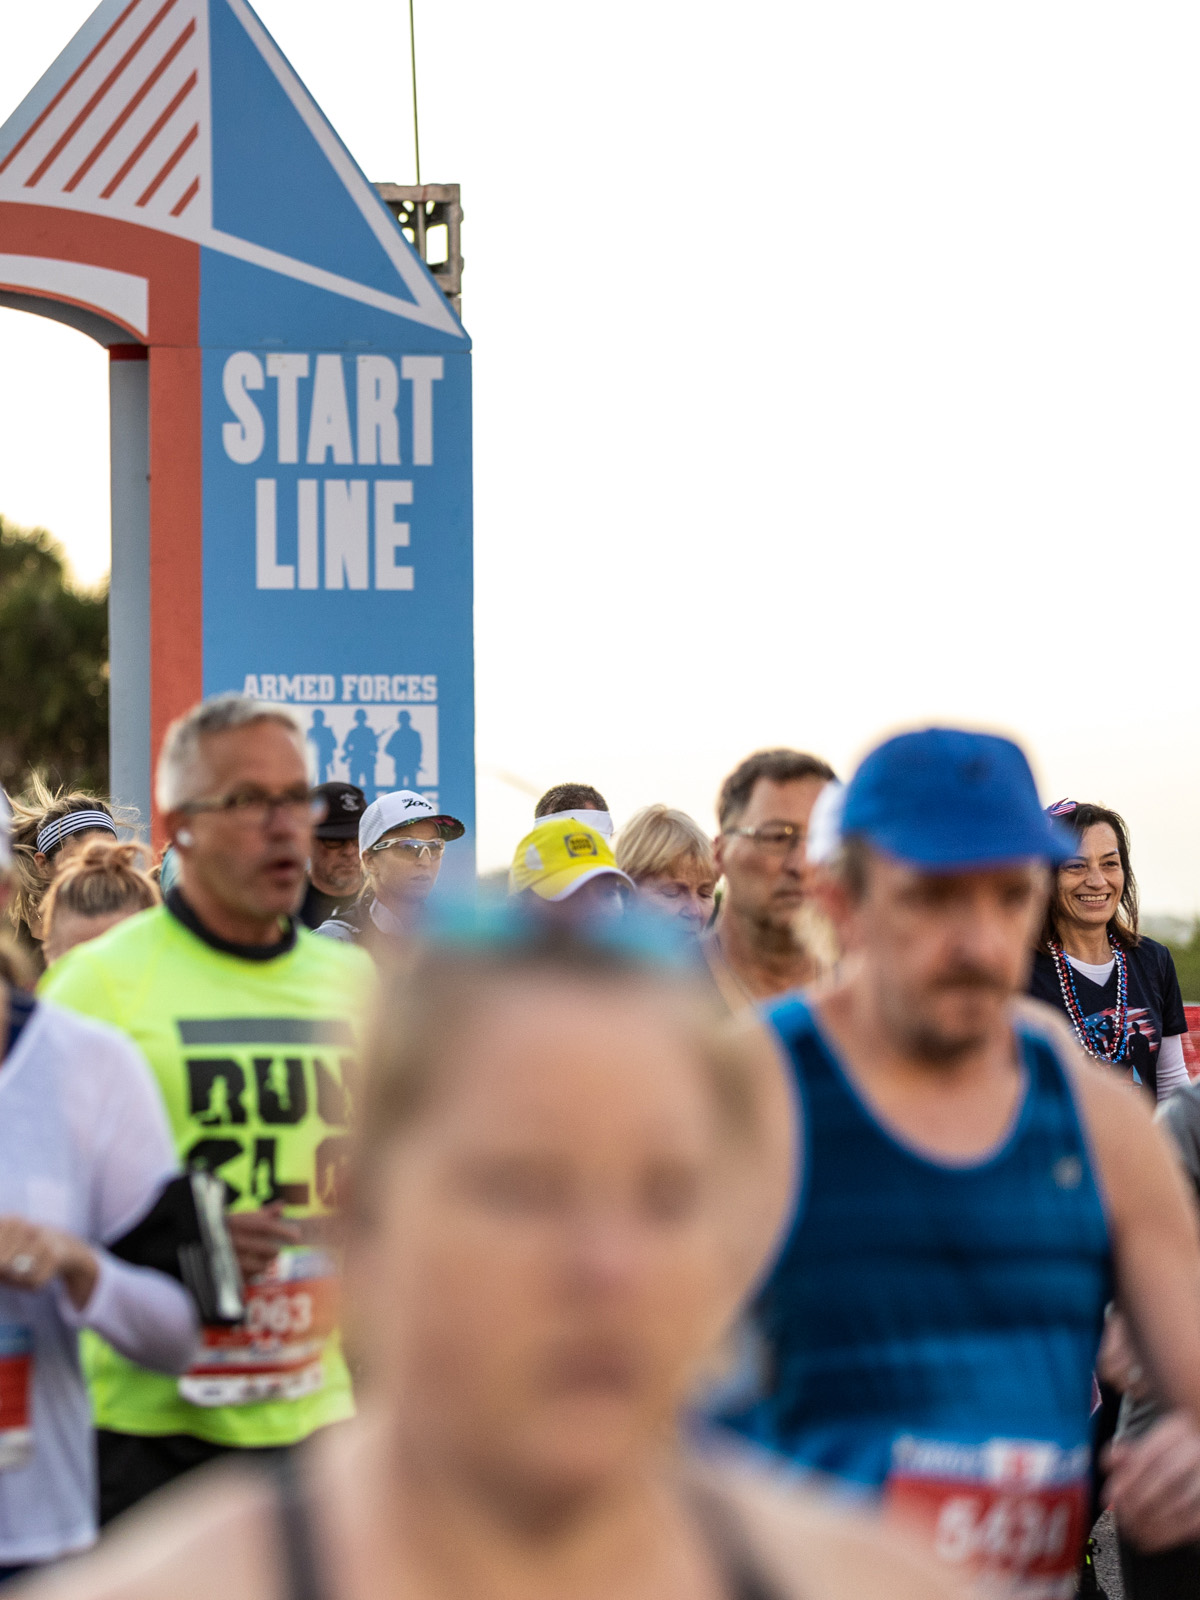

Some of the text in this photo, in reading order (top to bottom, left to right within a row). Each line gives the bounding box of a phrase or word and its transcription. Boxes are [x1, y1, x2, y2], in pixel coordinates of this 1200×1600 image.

[222, 351, 443, 466] START
[256, 478, 414, 590] LINE
[243, 674, 438, 702] ARMED FORCES
